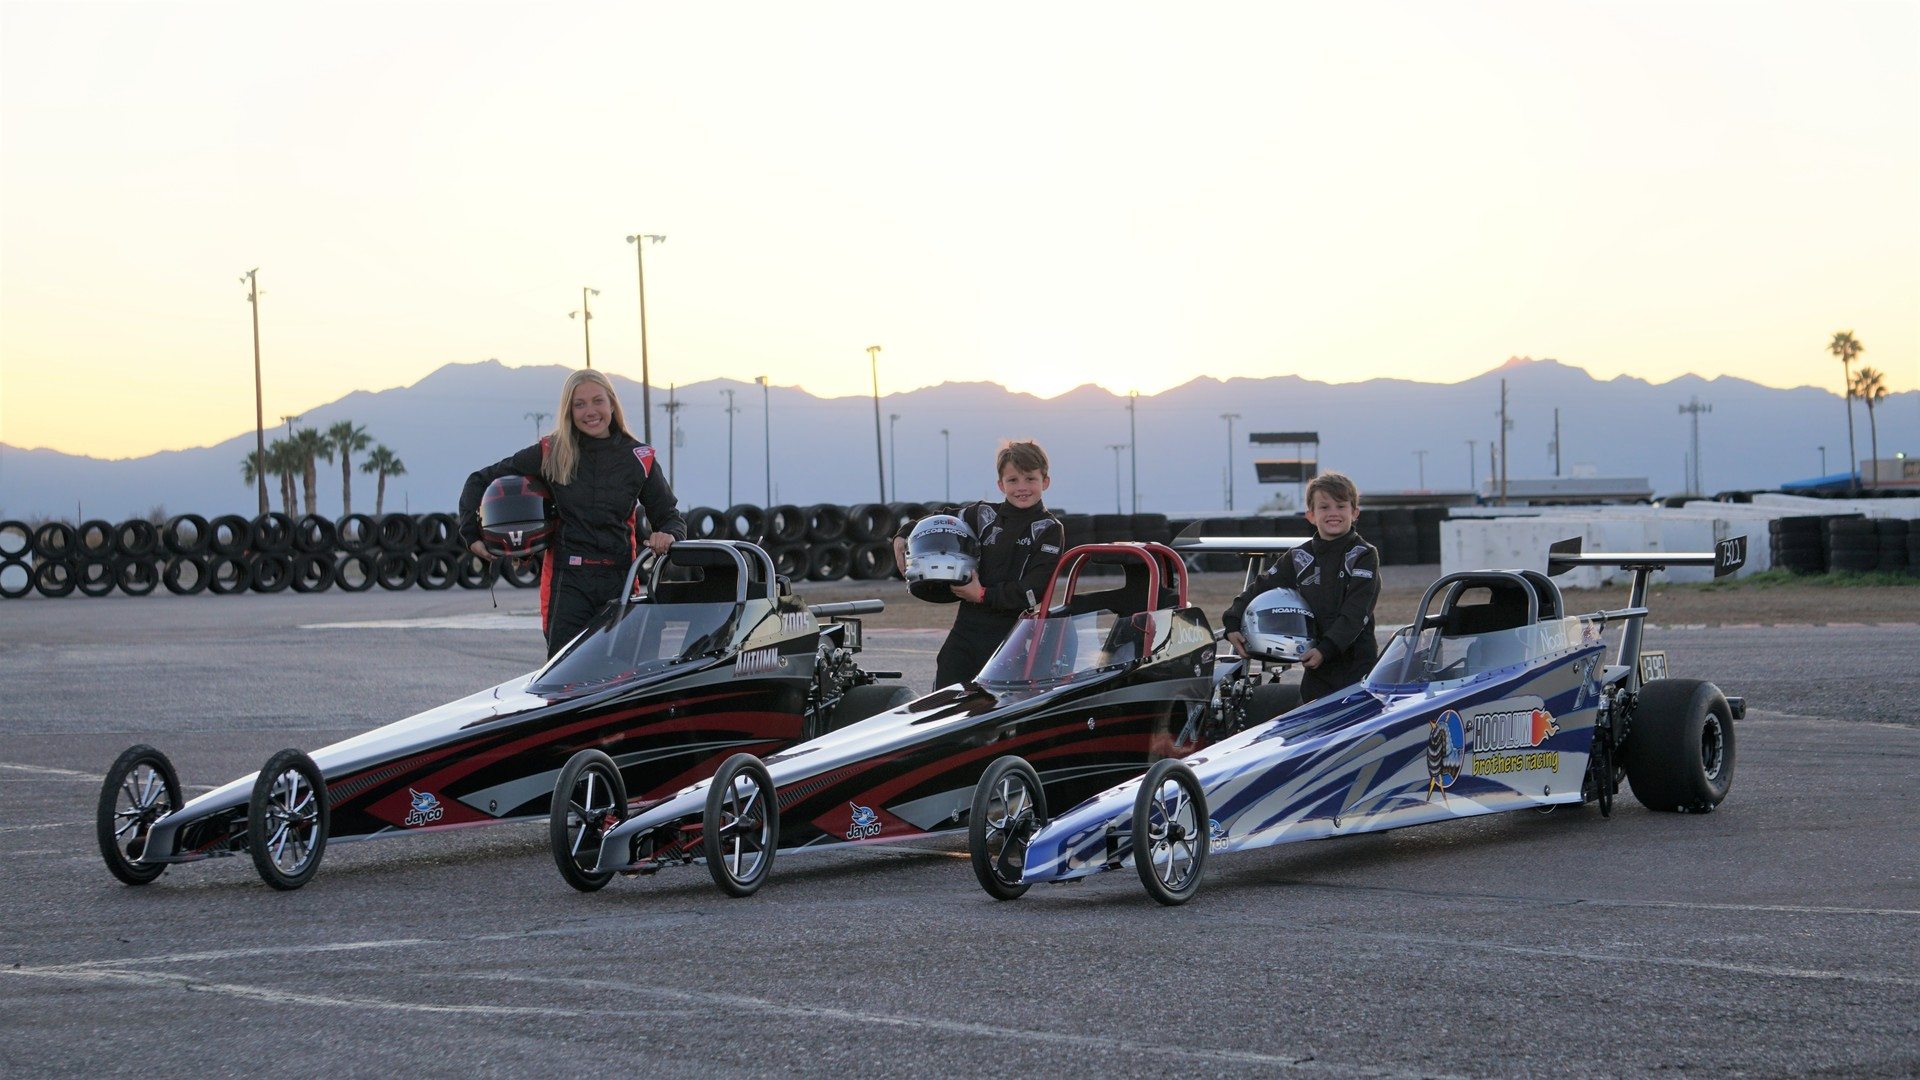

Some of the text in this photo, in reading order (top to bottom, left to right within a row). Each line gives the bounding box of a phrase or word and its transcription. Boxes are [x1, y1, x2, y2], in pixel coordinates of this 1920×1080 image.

[914, 528, 968, 540] JACOB HOOD
[733, 647, 778, 677] AUTUMN
[1473, 710, 1533, 753] HOODLUM
[1472, 751, 1560, 777] brothers racing
[405, 808, 444, 827] Jayco
[846, 822, 882, 841] Jayco
[1209, 837, 1229, 853] yco
